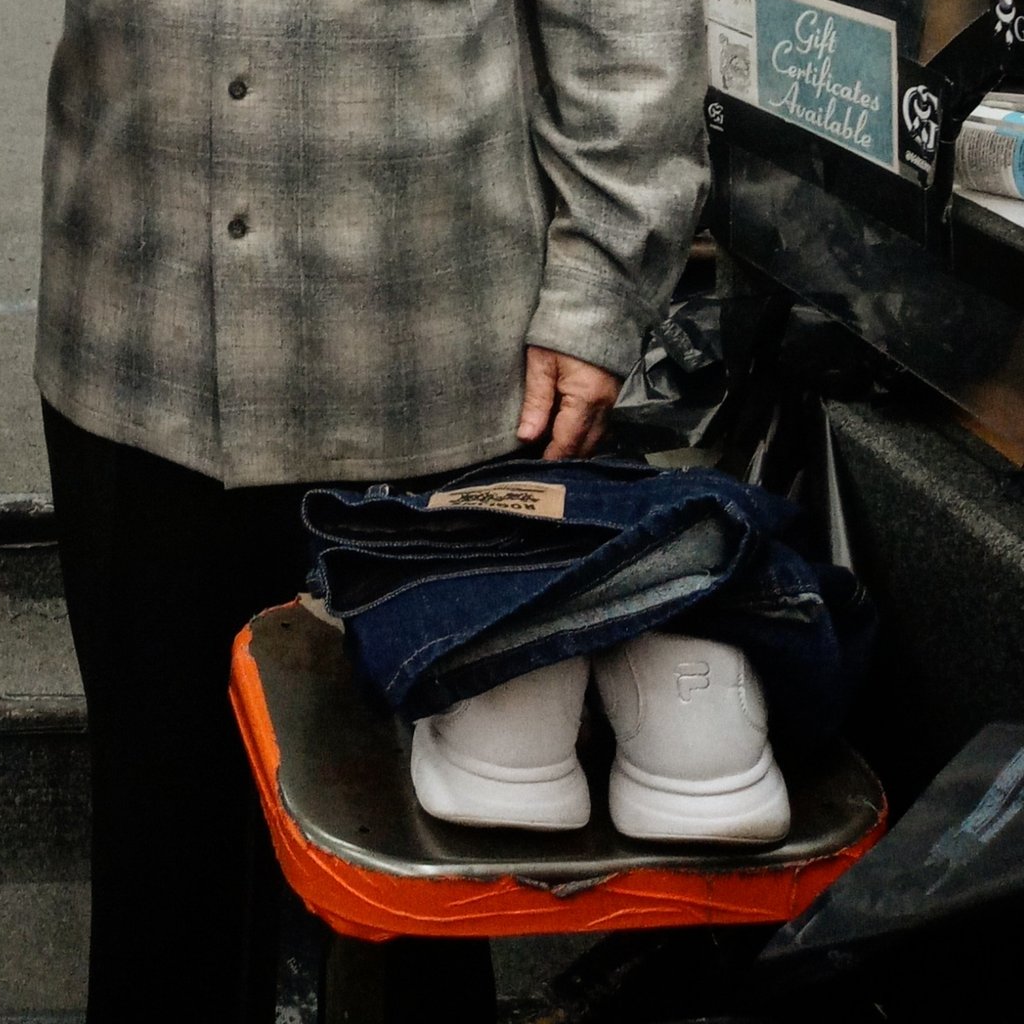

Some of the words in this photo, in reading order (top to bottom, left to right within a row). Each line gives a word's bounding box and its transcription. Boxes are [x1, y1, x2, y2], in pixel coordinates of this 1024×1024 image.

[794, 9, 837, 61] Gift
[771, 39, 881, 111] Certificates
[768, 81, 872, 148] Available
